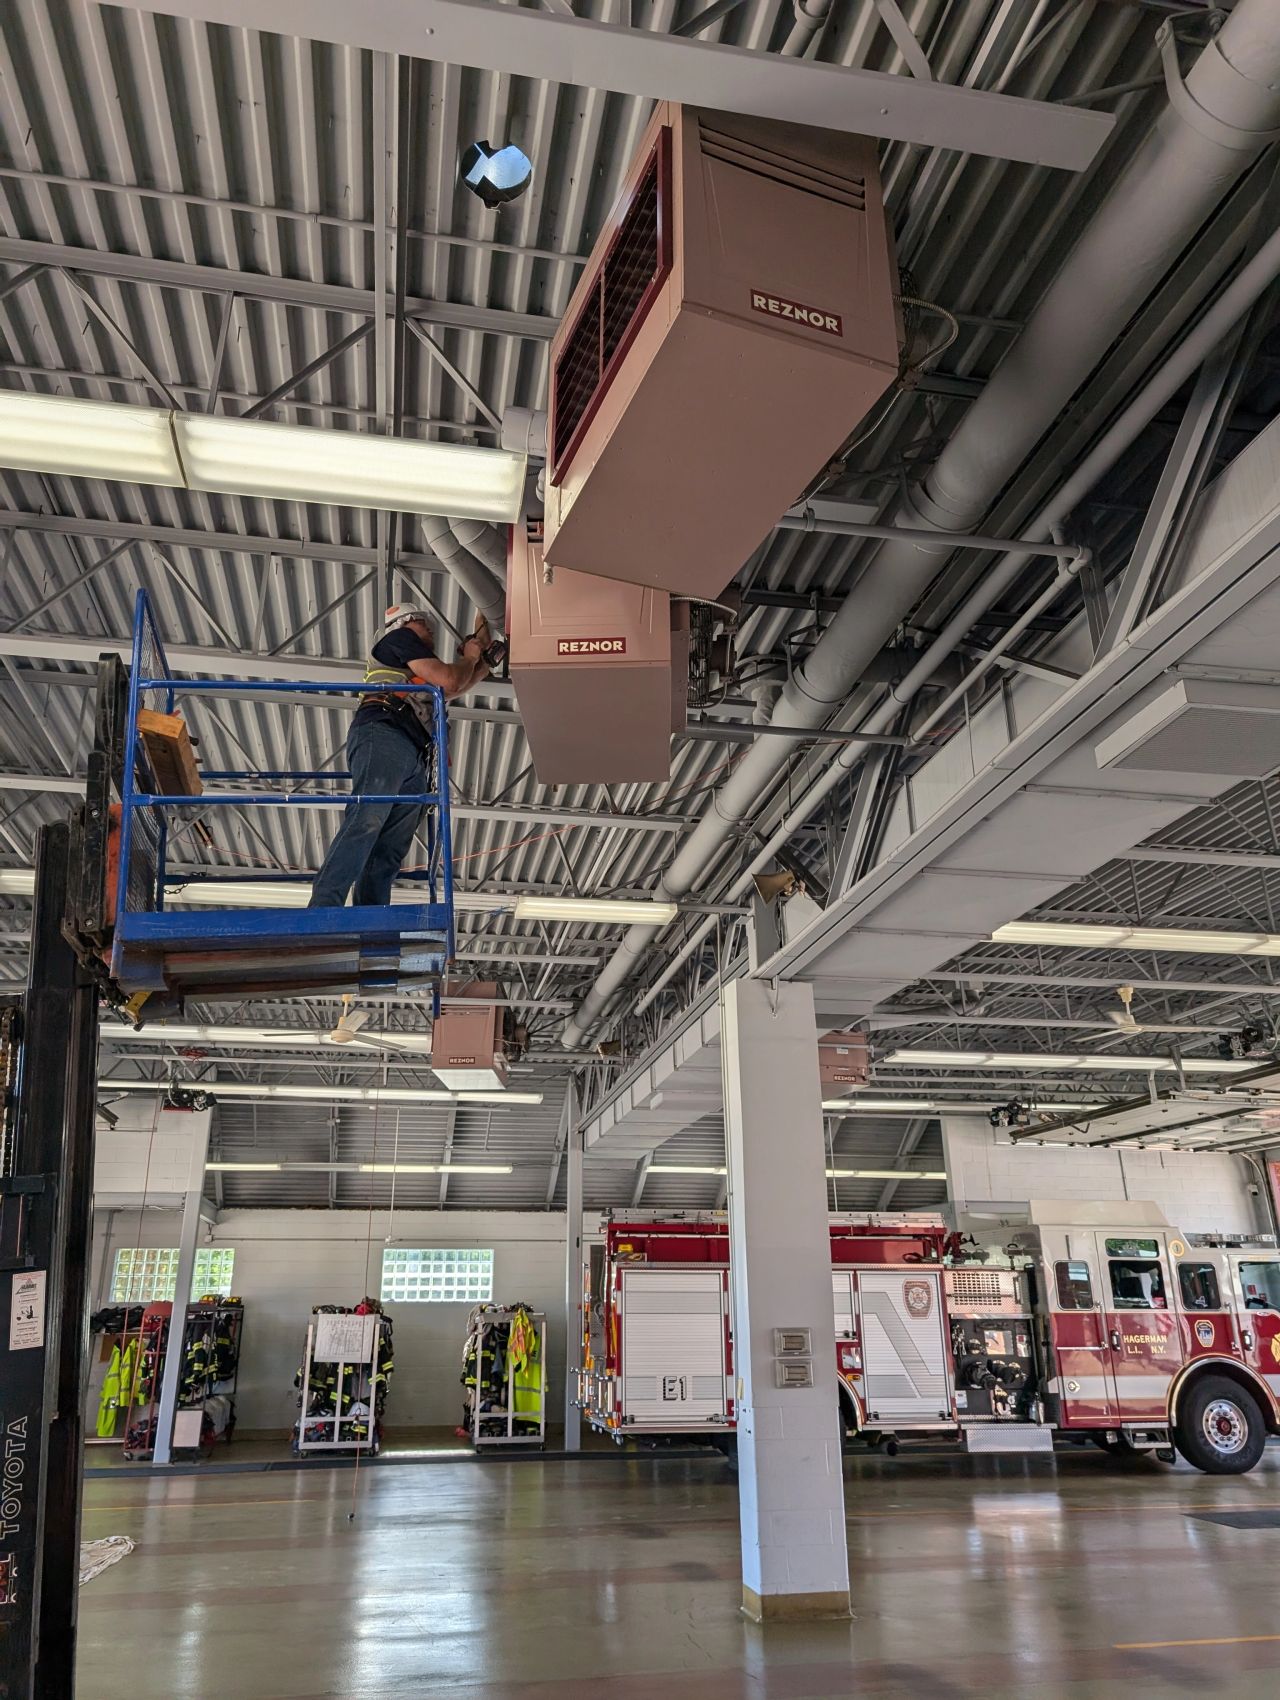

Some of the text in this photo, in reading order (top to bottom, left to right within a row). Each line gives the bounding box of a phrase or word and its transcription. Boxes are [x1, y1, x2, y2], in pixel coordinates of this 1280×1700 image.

[753, 294, 839, 332] REZNOR
[559, 641, 624, 653] REZNOR
[1123, 1334, 1168, 1343] HAGERMAN
[662, 1375, 688, 1401] E1
[0, 1416, 28, 1540] TOYOTA
